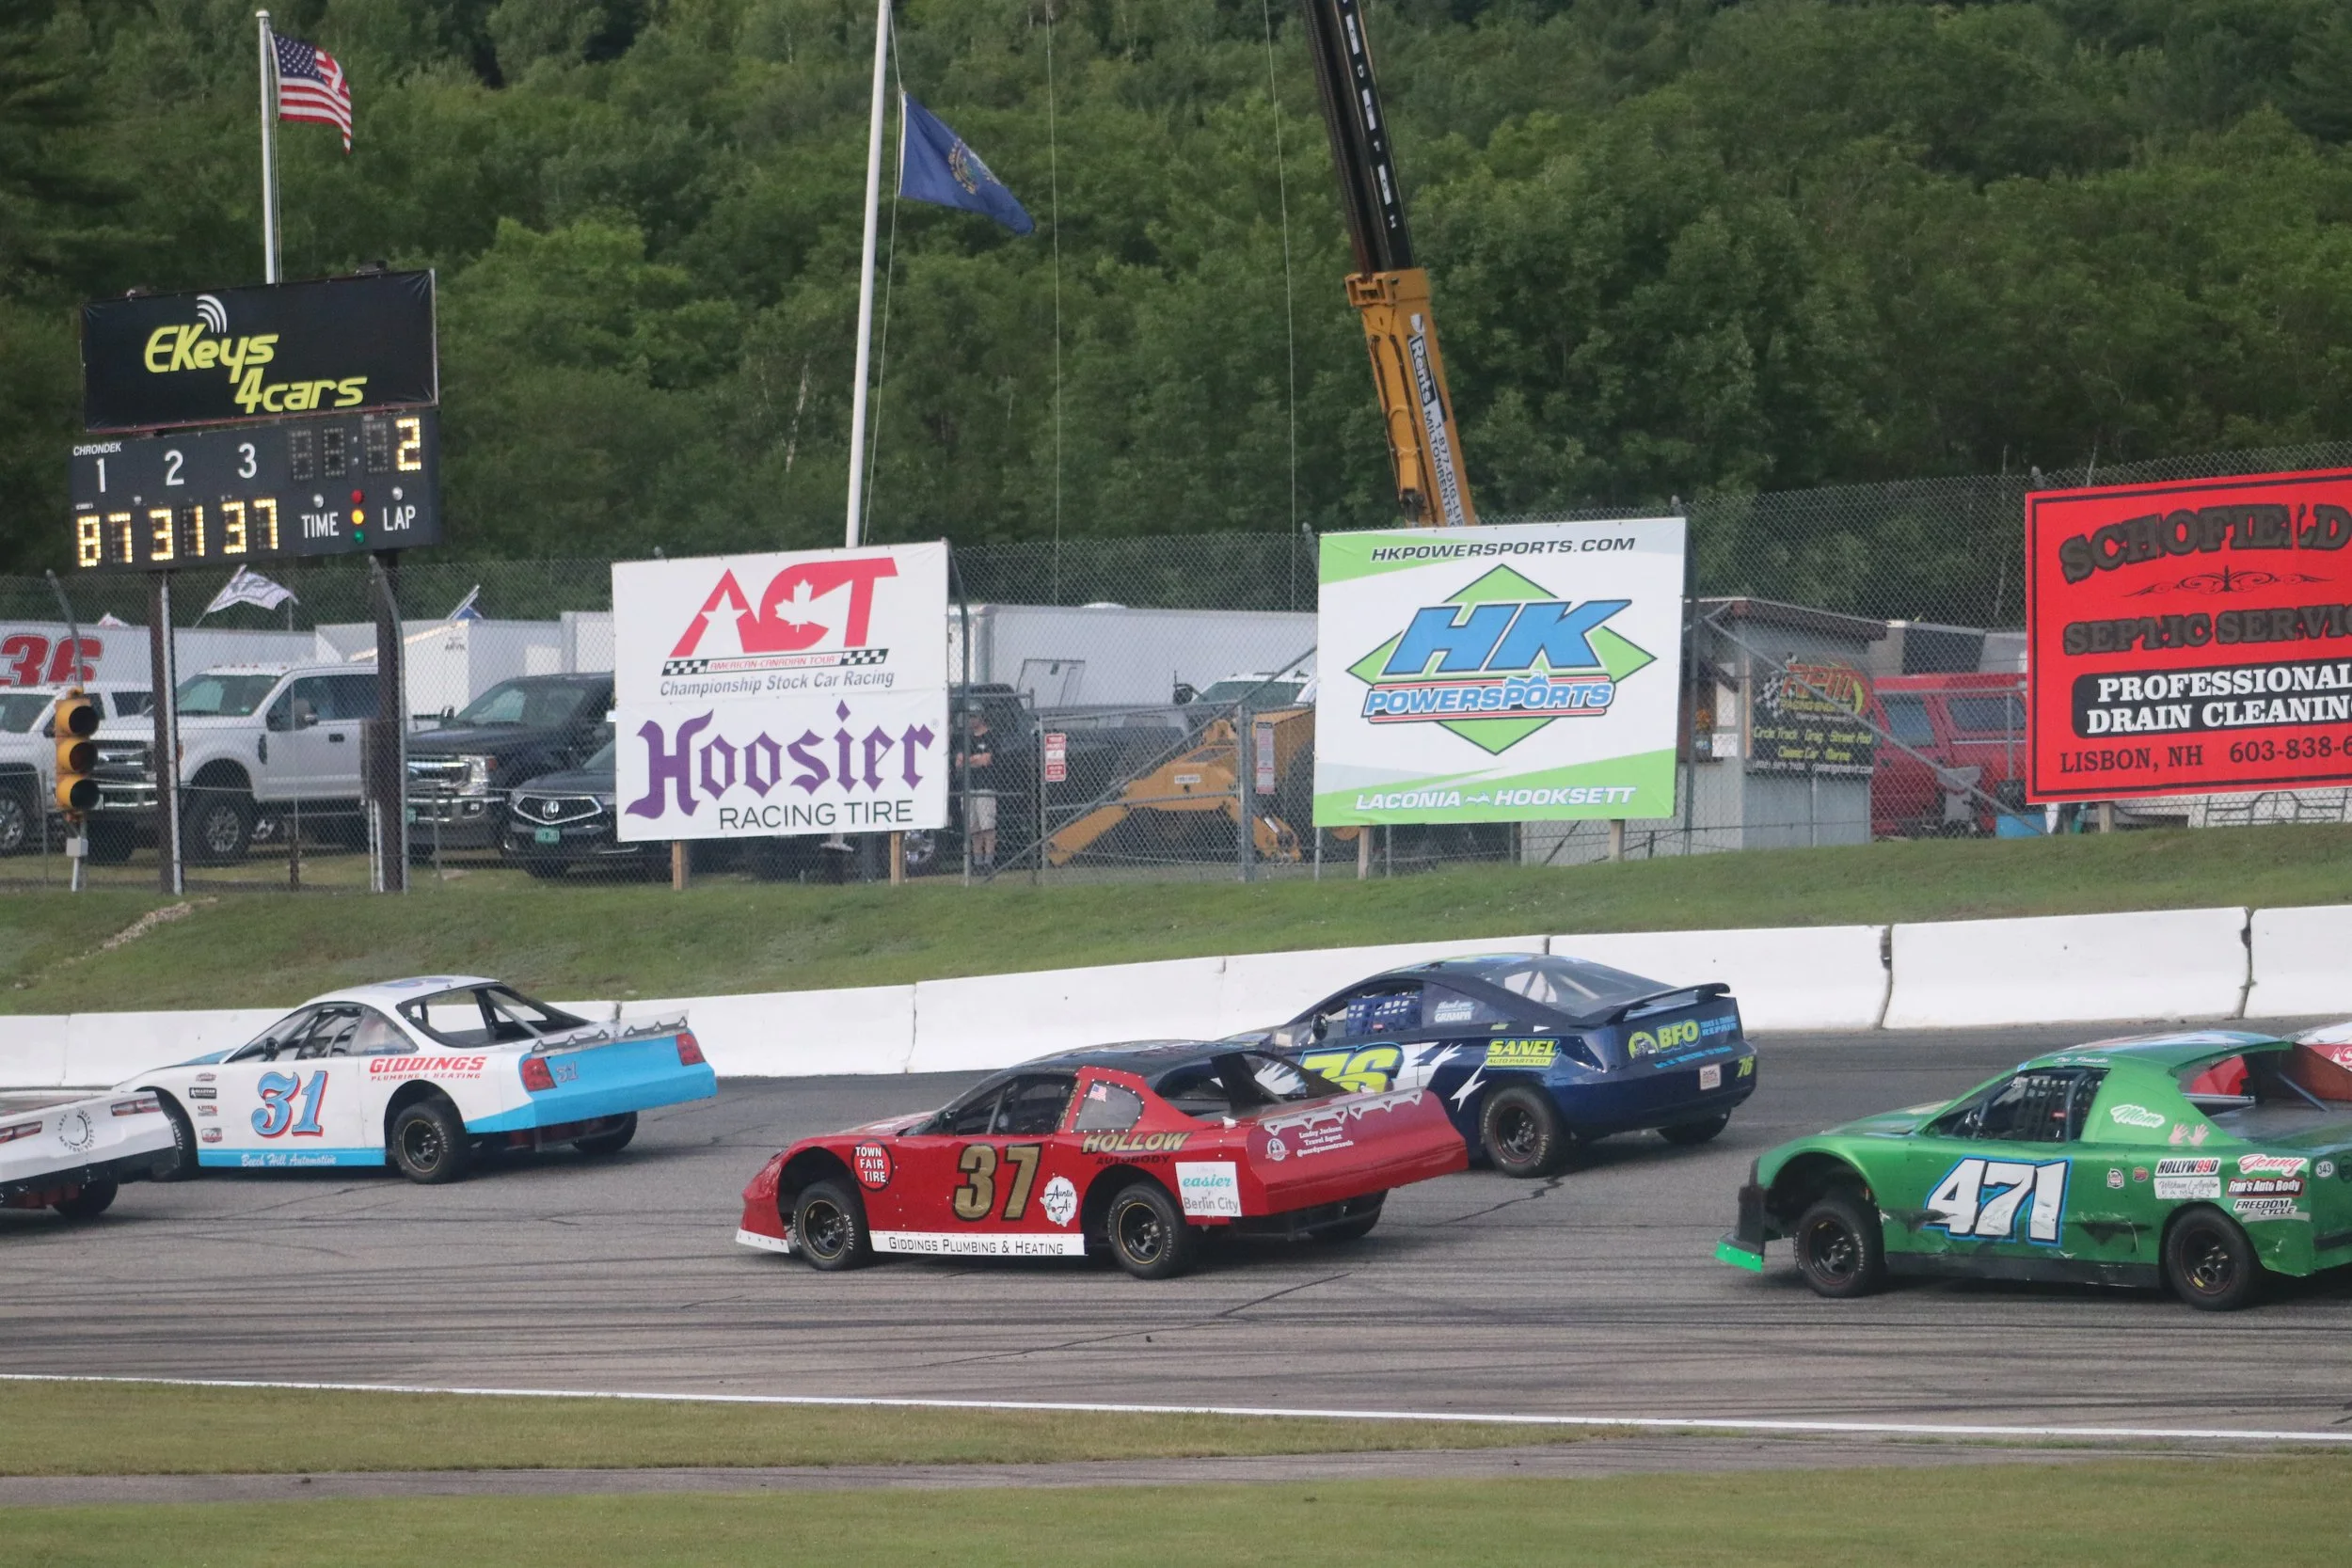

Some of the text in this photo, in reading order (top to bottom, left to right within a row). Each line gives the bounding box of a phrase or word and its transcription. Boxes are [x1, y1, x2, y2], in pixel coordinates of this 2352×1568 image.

[1412, 340, 1433, 406] Rents
[234, 367, 368, 414] 4cars
[72, 442, 122, 457] CHRONDEK
[395, 417, 422, 472] 2
[96, 443, 258, 494] 1 2 3
[301, 511, 340, 539] TIME
[382, 504, 417, 532] LAP
[1370, 536, 1636, 562] HKPOWERSPORTS.COM
[668, 556, 899, 658] ACT
[1380, 597, 1633, 676] HK
[2063, 612, 2212, 656] SEPTIC
[809, 655, 835, 665] TOUR
[660, 670, 895, 699] Championship Stock Car Racing
[1779, 663, 1855, 702] RPM
[2097, 663, 2352, 703] PROFESSIONAL
[1363, 682, 1613, 717] POWERSPORTS
[2086, 695, 2352, 735] DRAIN CLEANIN
[624, 698, 936, 820] Hoosier
[2060, 748, 2160, 774] LISBON,
[2168, 744, 2204, 768] NH
[1354, 785, 1637, 812] LACONIA HOOKSETT
[718, 800, 914, 831] RACING TIRE
[1486, 1040, 1558, 1056] SANEL
[1657, 1021, 1699, 1049] BFO
[369, 1055, 487, 1073] GIDDINGS
[1737, 1055, 1755, 1079] 76
[250, 1069, 328, 1138] 31
[855, 1146, 882, 1158] TOWN
[1081, 1131, 1192, 1155] HOLLOW
[266, 1152, 287, 1166] Hill
[289, 1152, 338, 1166] Automotive
[859, 1158, 885, 1170] FAIR
[1095, 1154, 1172, 1166] AUTOBODY
[2238, 1154, 2306, 1176] Jenny
[2316, 1163, 2332, 1175] 343
[863, 1170, 887, 1183] TIRE
[954, 1144, 1043, 1221] 37
[1182, 1173, 1232, 1188] easier
[2228, 1179, 2301, 1193] Fran's Auto Body
[1183, 1196, 1239, 1214] Berlin City
[1925, 1156, 2070, 1244] 471
[2234, 1198, 2290, 1210] FREEDOM
[2259, 1206, 2296, 1216] CYCLE
[888, 1236, 1064, 1255] GIDDINGS PLUMBING & HEATING
